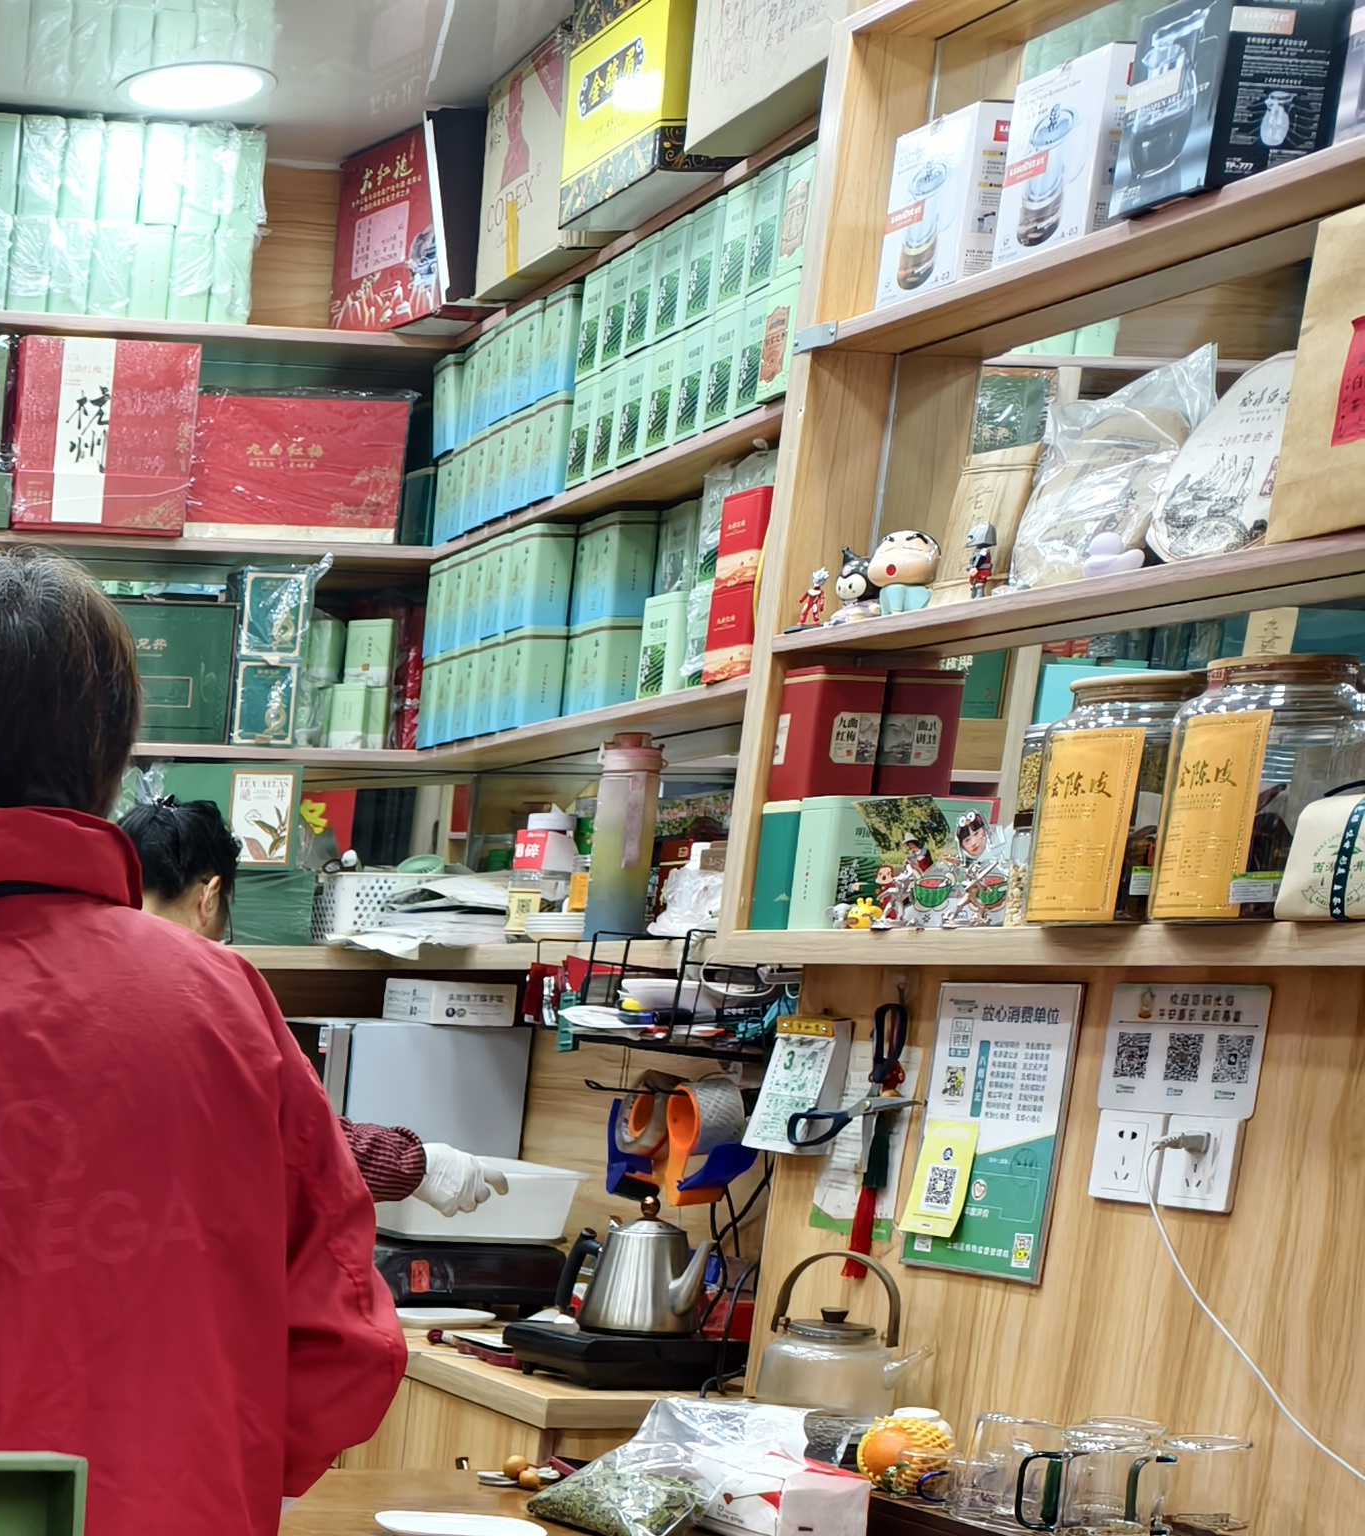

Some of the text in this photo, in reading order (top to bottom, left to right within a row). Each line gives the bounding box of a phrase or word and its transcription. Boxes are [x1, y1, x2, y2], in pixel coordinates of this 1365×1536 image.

[65, 385, 111, 473] 杭州
[981, 1004, 1061, 1026] 放心消费单位
